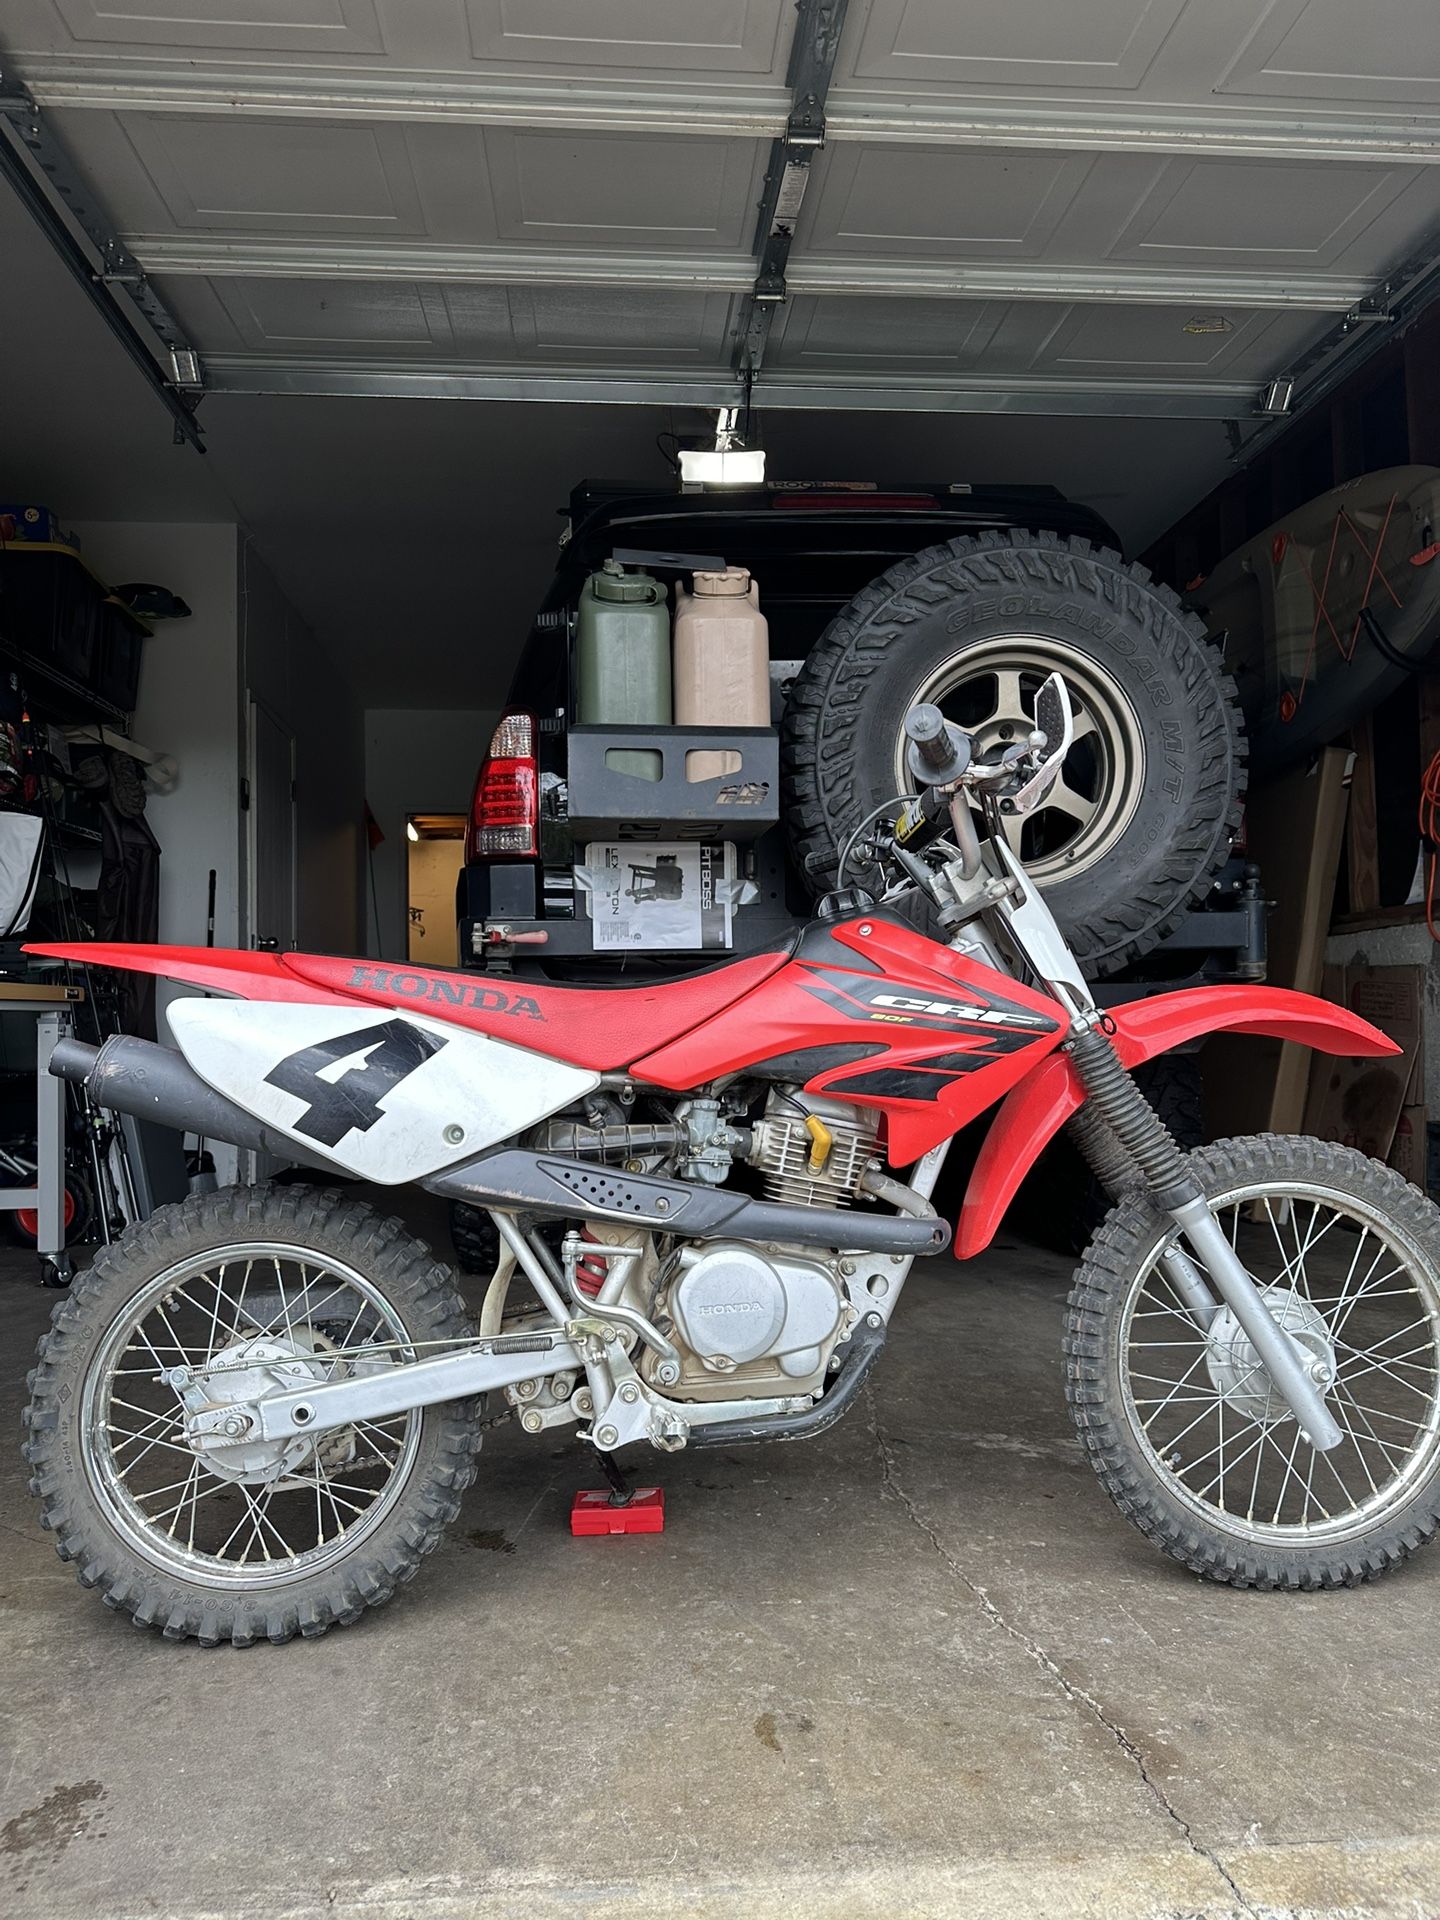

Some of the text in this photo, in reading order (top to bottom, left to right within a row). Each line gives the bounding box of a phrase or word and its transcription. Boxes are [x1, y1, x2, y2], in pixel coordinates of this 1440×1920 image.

[944, 594, 1186, 804] GEOLANDAR M/T
[611, 847, 619, 915] LEXTON
[701, 846, 712, 910] PIT BOSS
[346, 965, 549, 1023] HONDA
[869, 994, 1043, 1025] CRF
[869, 1013, 914, 1023] 80F
[263, 1017, 450, 1148] 4
[699, 1302, 765, 1316] HONDA
